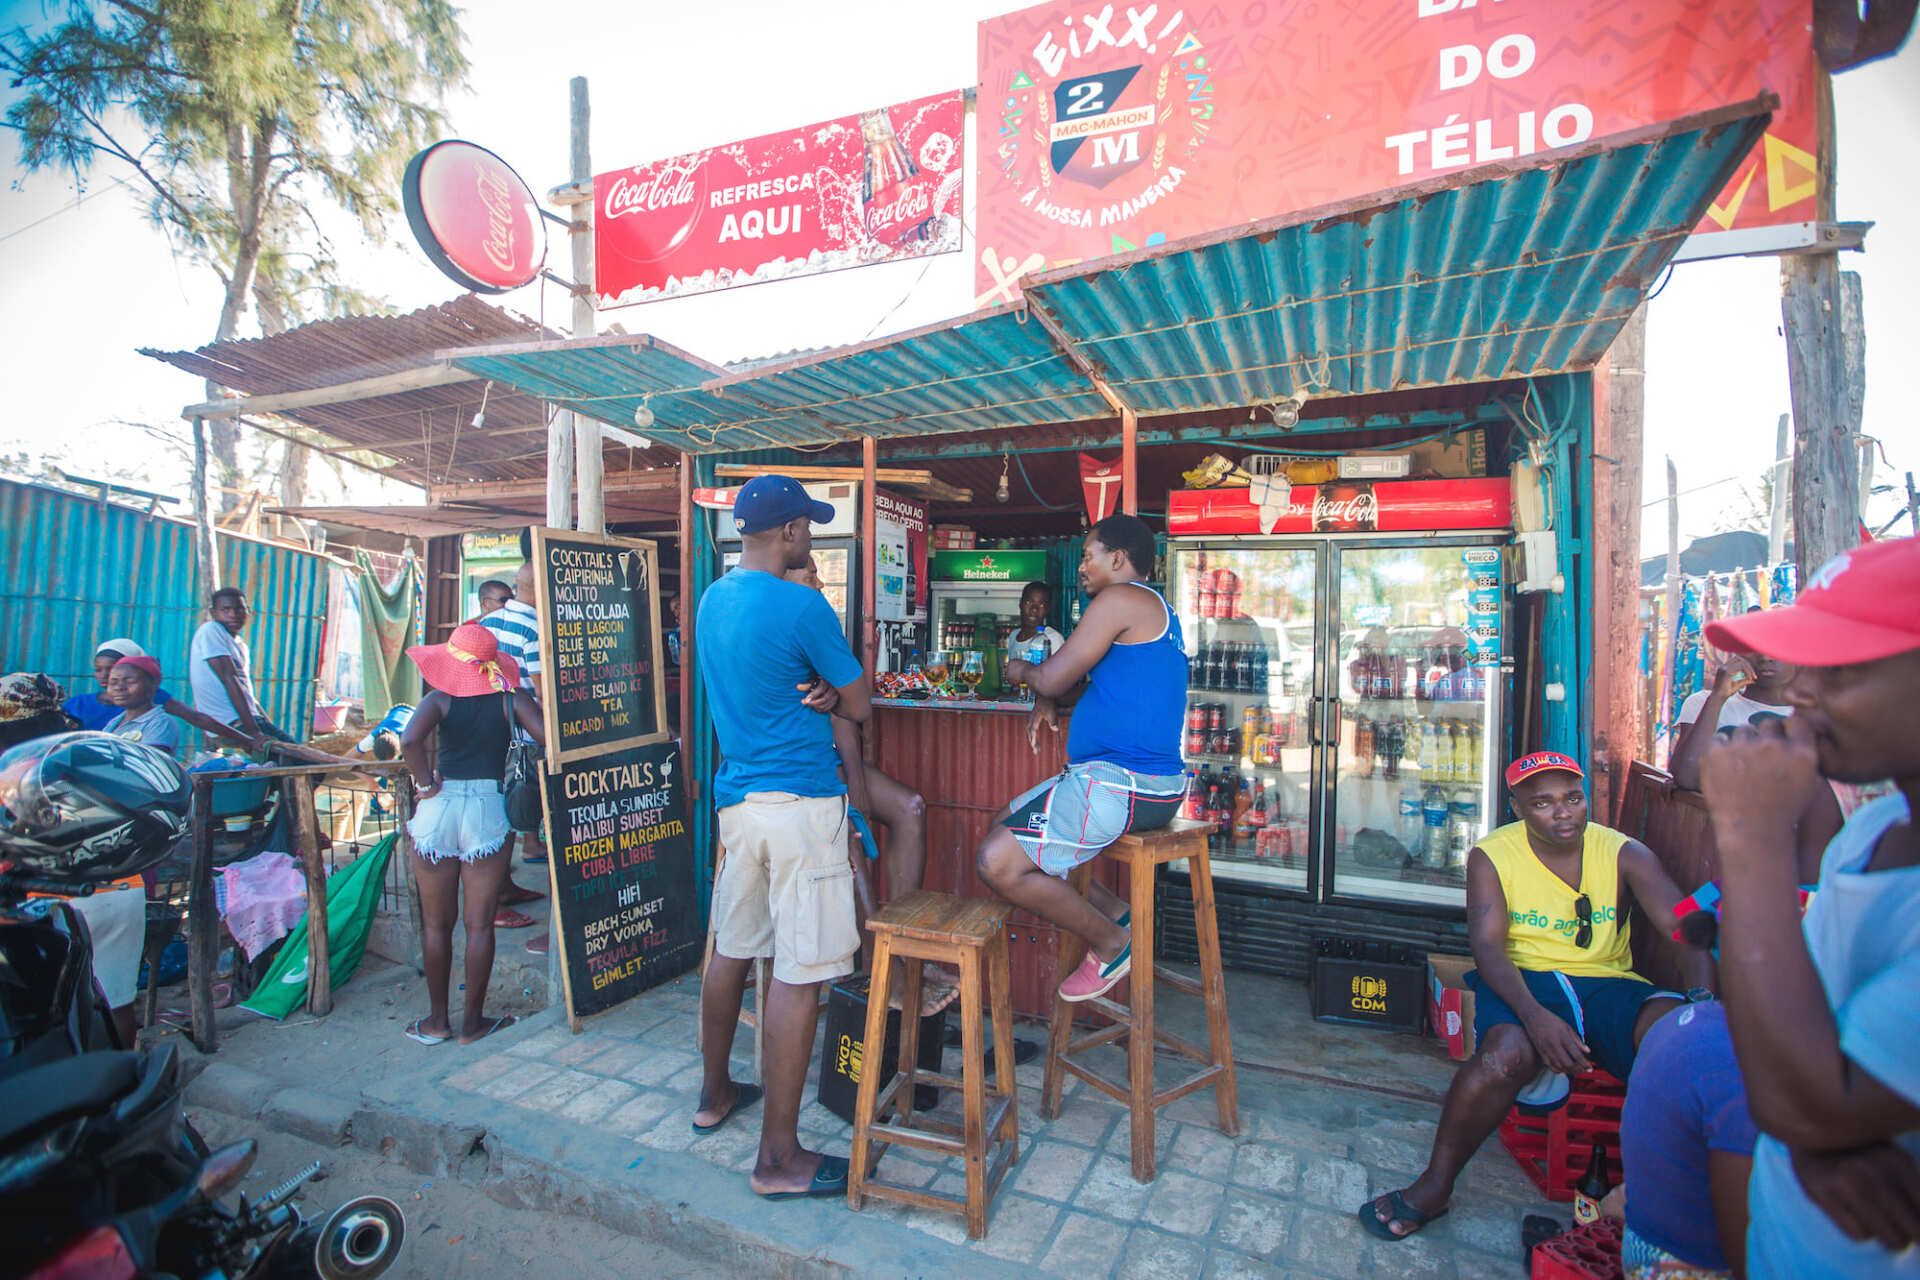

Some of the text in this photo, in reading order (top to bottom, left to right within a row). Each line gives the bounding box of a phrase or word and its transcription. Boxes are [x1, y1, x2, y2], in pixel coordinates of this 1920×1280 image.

[1439, 34, 1537, 91] DO
[1067, 81, 1104, 116] 2
[1056, 111, 1149, 137] MAC-MAHON
[1091, 131, 1140, 168] M
[1384, 103, 1594, 175] TÉLIO
[605, 165, 697, 219] Coca-Cola
[710, 172, 815, 208] REFRESCA
[1034, 198, 1092, 228] NOSSA
[1100, 166, 1187, 227] MANEIRA
[718, 204, 801, 243] AQUI
[895, 502, 913, 517] AQUI
[913, 508, 923, 520] AO
[555, 568, 615, 585] CAIPIRINHA
[963, 568, 1010, 579] Heineken
[555, 586, 598, 602] MOJITO
[557, 603, 630, 621] PINA COLADA
[557, 621, 624, 637] BLUE LAGOON
[558, 636, 618, 653] BLUE MOON
[559, 650, 609, 668] BLUE SEA
[560, 668, 587, 686] BLUE
[592, 681, 627, 699] ISLAND
[600, 697, 623, 712] TEA
[562, 716, 605, 737] BACARDI
[568, 788, 670, 825] TEQUILA SUNRISE
[571, 808, 664, 844] MALIBU SUNSET
[564, 819, 684, 865] FROZEN MARGARITA
[582, 855, 615, 880] CUBA
[584, 897, 664, 939] BEACH SUNSET
[585, 918, 653, 956] DRY VODKA
[1352, 997, 1386, 1012] CDM
[837, 1035, 851, 1074] CDM
